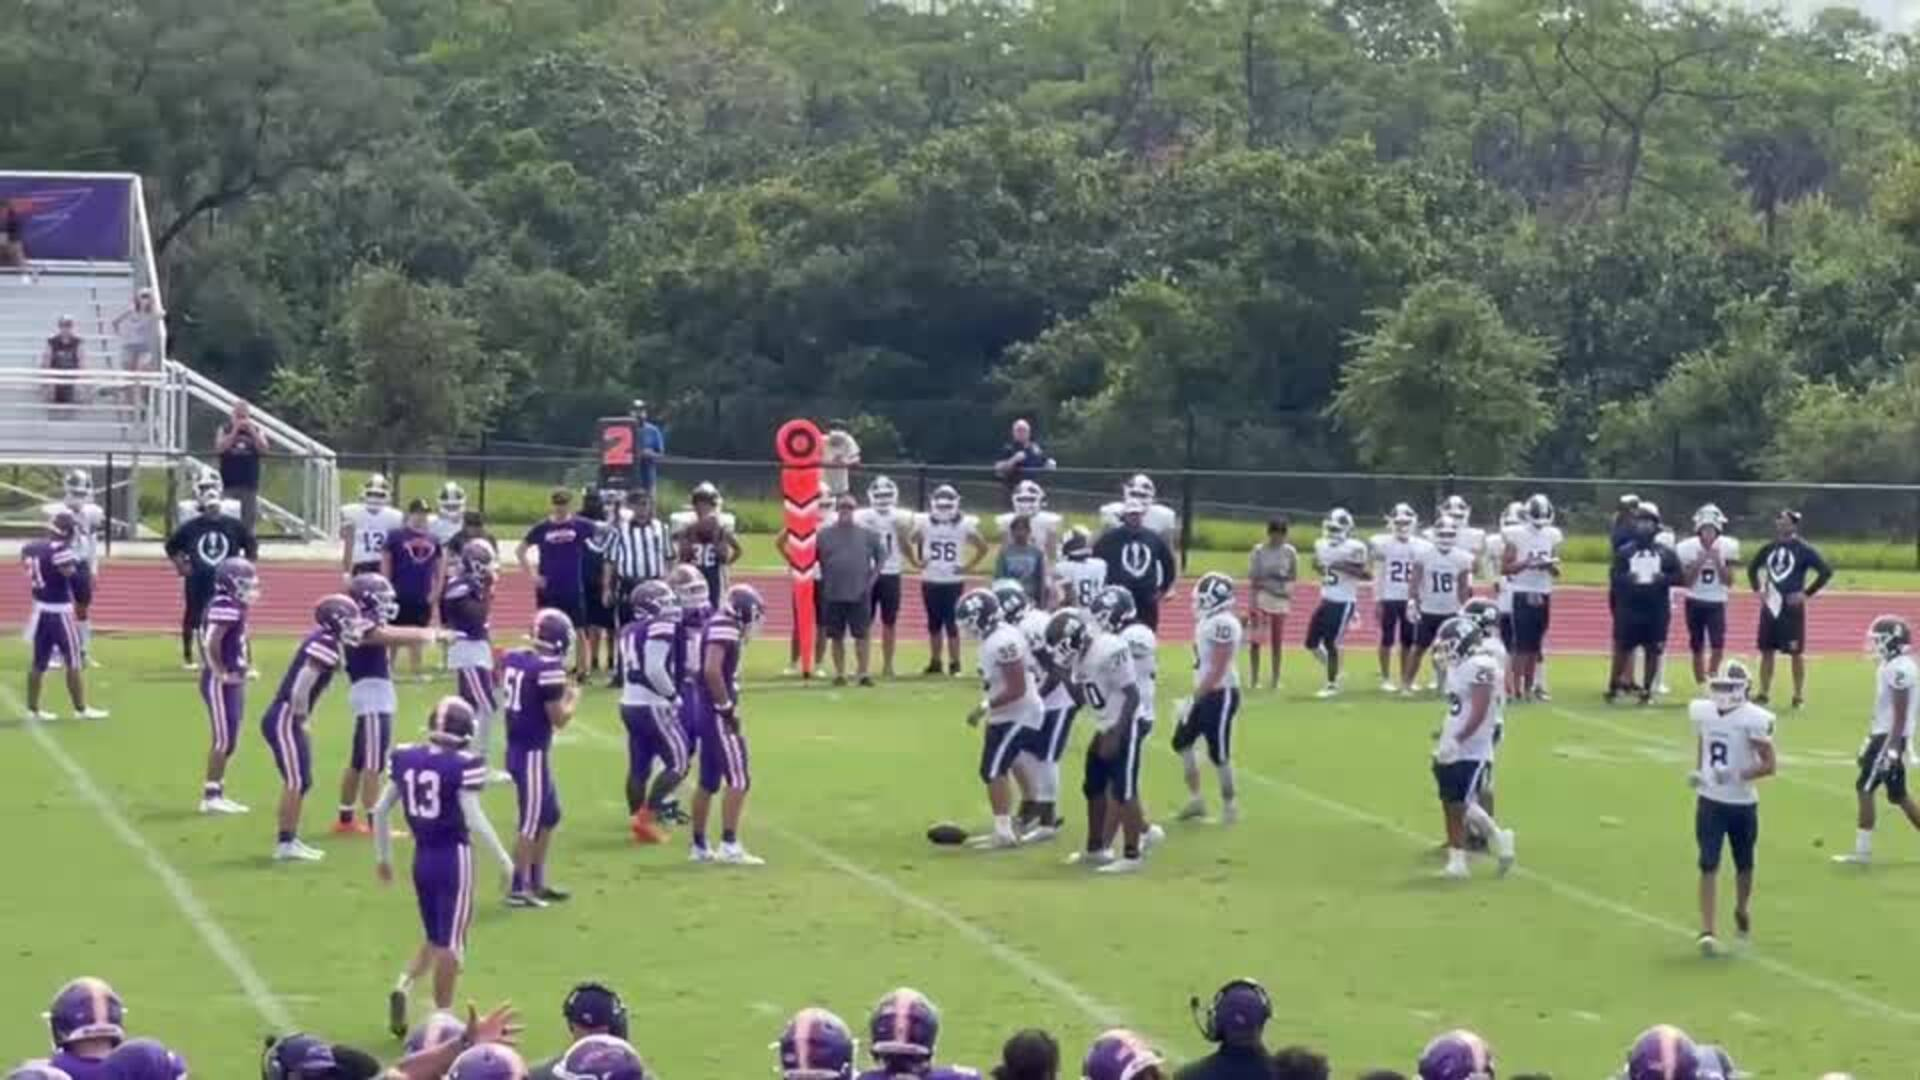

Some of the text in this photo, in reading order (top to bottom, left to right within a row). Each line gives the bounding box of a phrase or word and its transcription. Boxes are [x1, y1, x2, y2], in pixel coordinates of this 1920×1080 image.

[603, 426, 633, 464] 2
[930, 542, 957, 562] 56
[404, 768, 440, 820] 13
